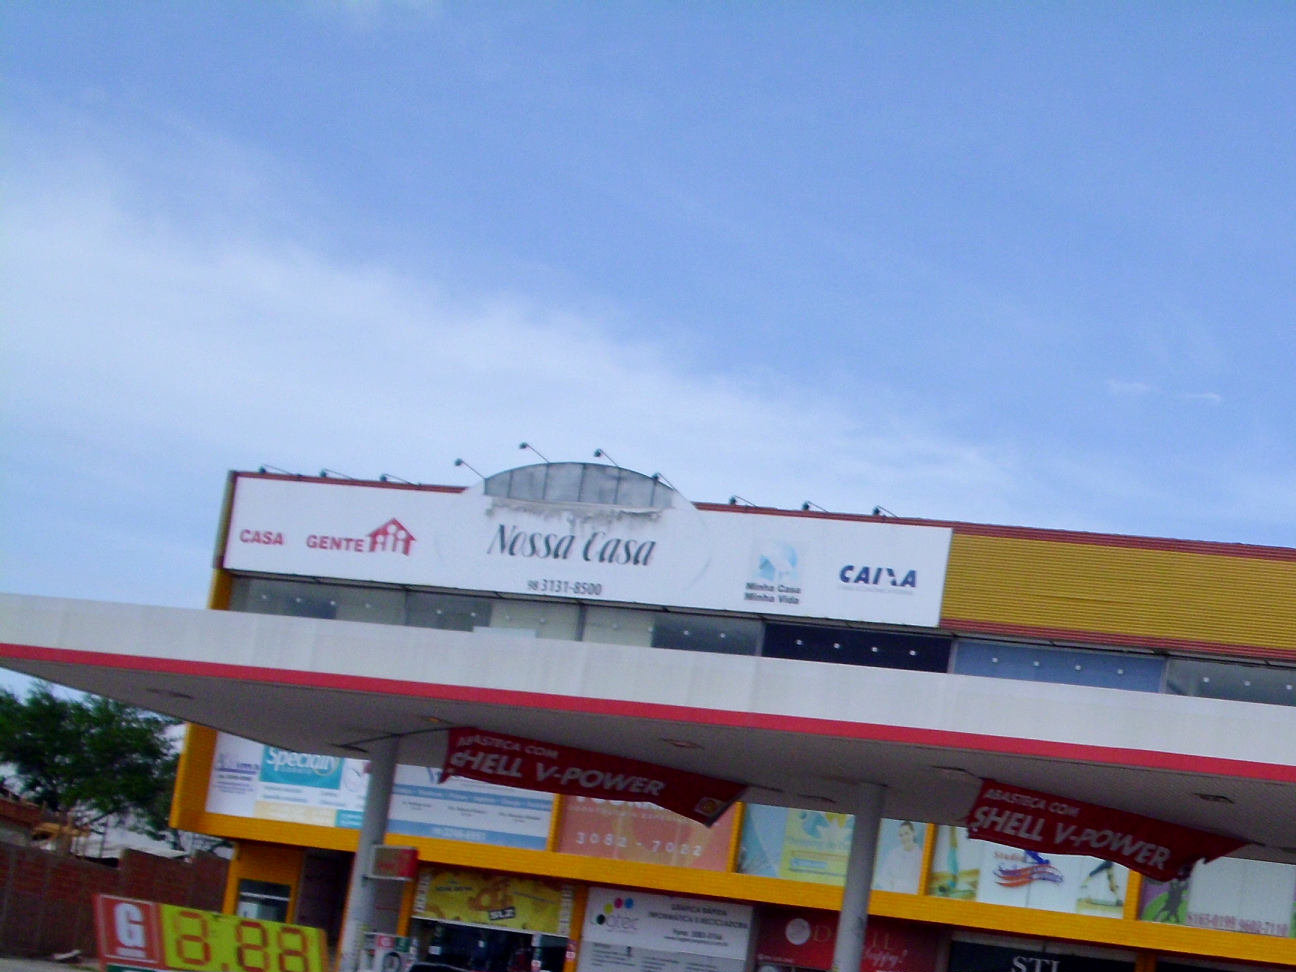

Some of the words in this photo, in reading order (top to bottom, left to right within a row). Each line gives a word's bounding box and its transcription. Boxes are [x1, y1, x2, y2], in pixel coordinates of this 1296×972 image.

[239, 529, 284, 546] CASA
[306, 534, 365, 553] GENTE
[486, 523, 576, 560] Nossa
[582, 531, 657, 566] Casa
[541, 578, 603, 596] 3131-8500
[745, 582, 775, 592] Minha
[777, 584, 801, 594] Casa
[839, 564, 918, 589] CAIXA
[744, 592, 775, 603] Minha
[778, 593, 800, 605] Vida
[525, 743, 560, 760] COM
[535, 761, 667, 797] V-POWER
[1048, 800, 1082, 818] COM
[970, 805, 1047, 842] SHELL
[1053, 821, 1173, 871] V-POWER
[114, 902, 147, 948] G
